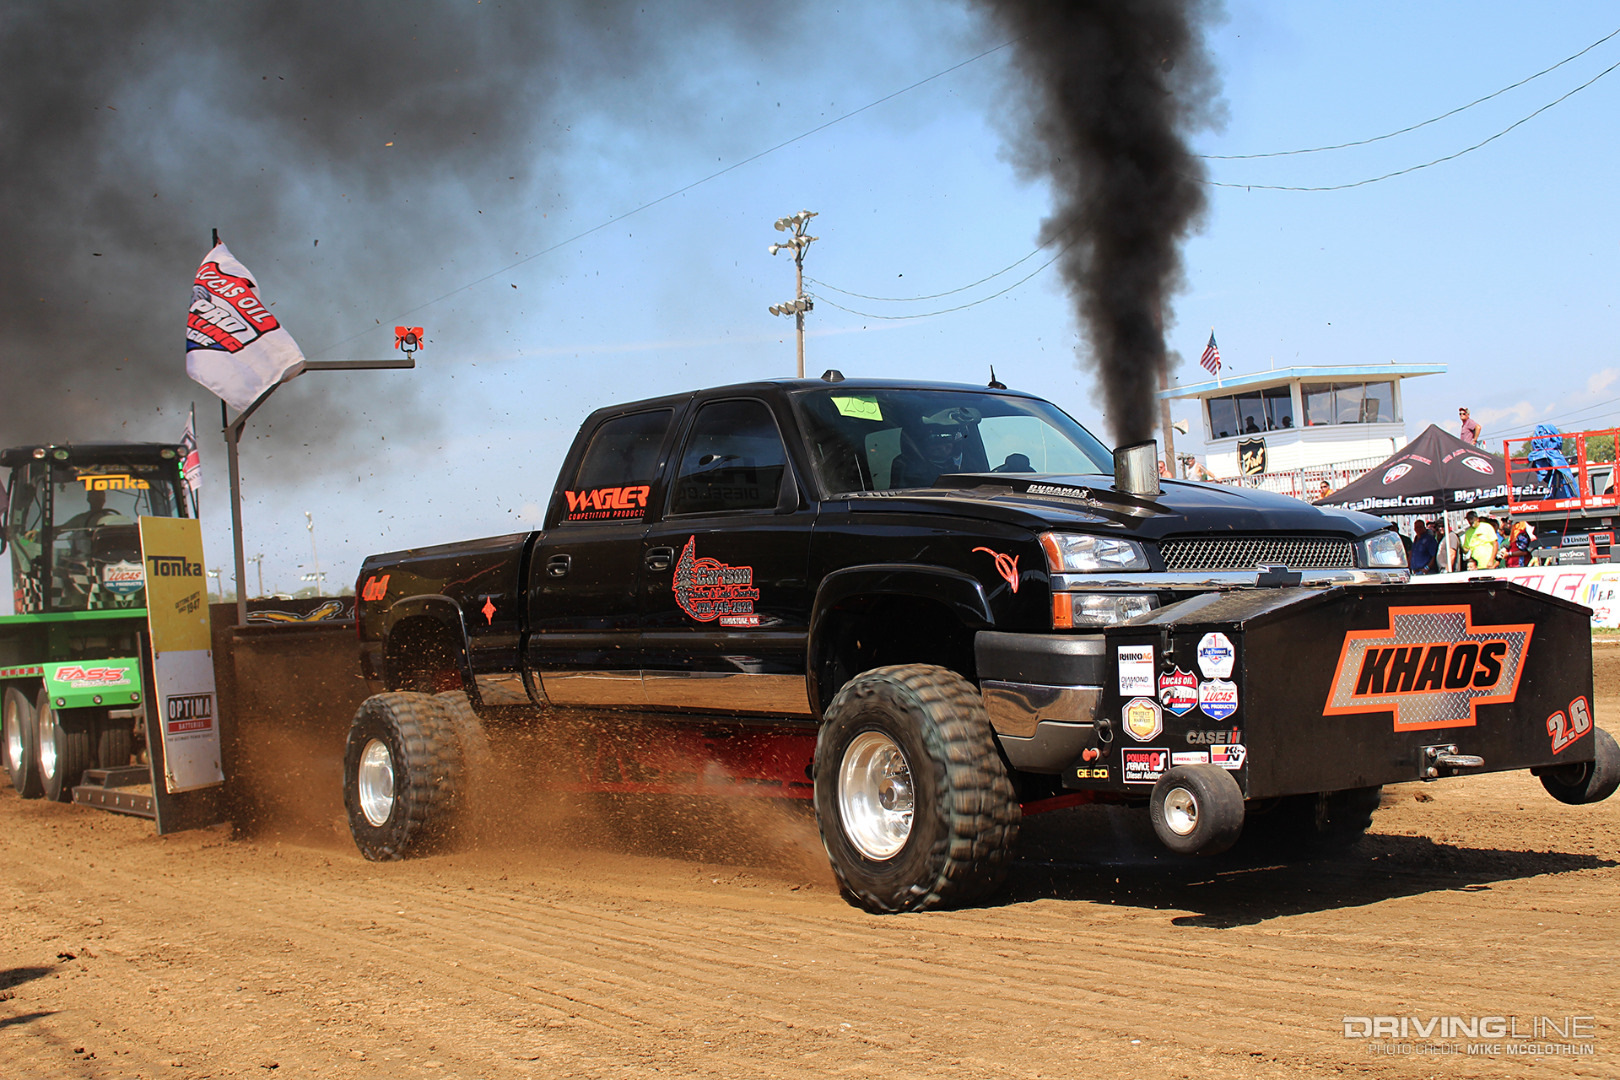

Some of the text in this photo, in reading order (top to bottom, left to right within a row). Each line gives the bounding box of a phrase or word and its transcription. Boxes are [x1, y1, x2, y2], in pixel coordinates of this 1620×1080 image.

[195, 265, 272, 324] LUCAS OIL
[189, 298, 247, 334] PRO
[187, 313, 244, 353] LLING
[76, 474, 150, 491] Tonka
[564, 485, 650, 512] WAGLER
[1026, 484, 1090, 499] DURAMAX
[568, 508, 646, 520] COMPETITION PRODUCTS
[1511, 503, 1540, 511] SKYJACK
[1559, 550, 1586, 558] SKYJACK
[147, 556, 203, 576] Tonka
[109, 571, 142, 581] LUCAS
[697, 566, 752, 585] Carlson
[55, 666, 127, 682] FASS
[1355, 642, 1508, 695] KHAOS
[1162, 676, 1193, 685] LUCAS OIL
[1203, 691, 1235, 702] LUCAS
[169, 698, 211, 719] OPTIMA
[178, 721, 204, 730] BATTERIES
[1548, 697, 1590, 752] 2.6
[1186, 731, 1226, 744] CASE
[1126, 754, 1150, 762] POWER
[1125, 762, 1150, 771] SERVICE
[1077, 769, 1109, 779] GEICO
[1126, 771, 1143, 779] Diesel
